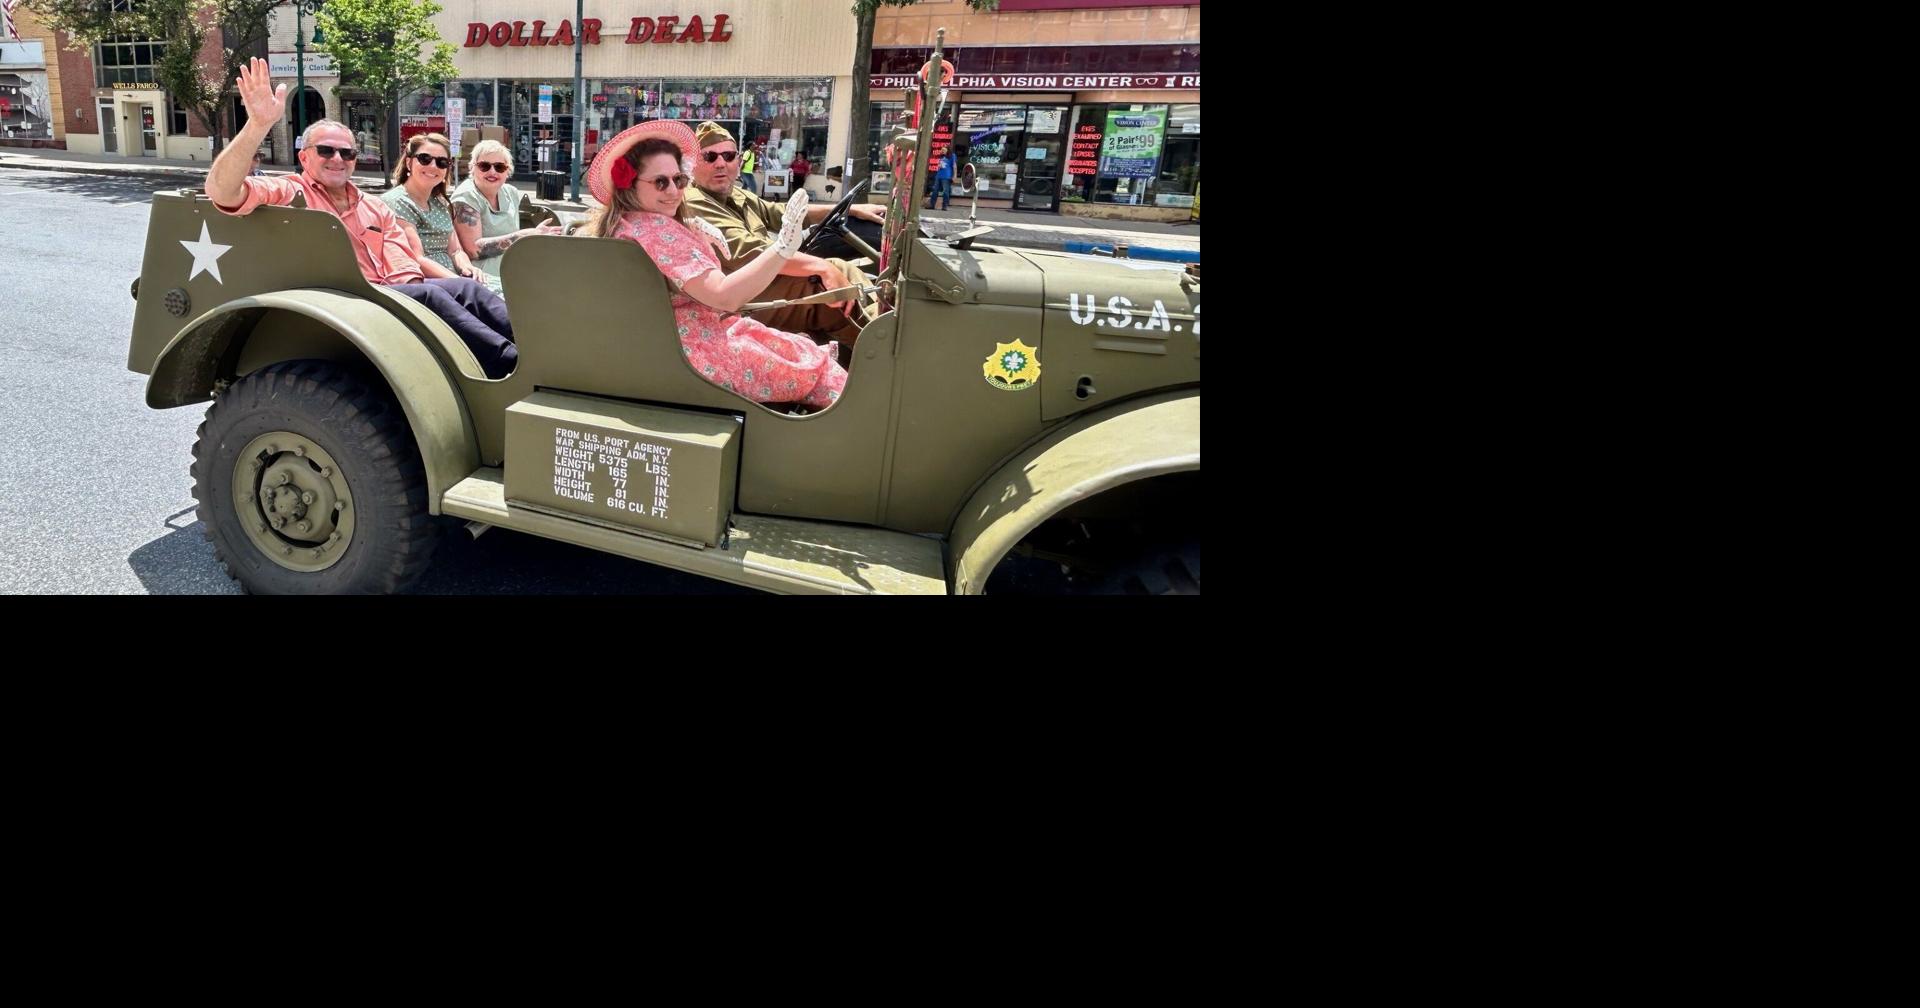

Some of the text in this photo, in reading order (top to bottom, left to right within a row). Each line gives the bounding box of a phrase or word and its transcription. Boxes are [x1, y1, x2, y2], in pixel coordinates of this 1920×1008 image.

[464, 14, 733, 48] DOLLAR DEAL
[885, 77, 1132, 87] PHILLPHIA VISION CENTER
[1109, 137, 1115, 145] 2
[1118, 136, 1135, 145] Pair
[1070, 293, 1182, 332] U.S.A.
[555, 427, 672, 457] FROM U.S. PORT AGENCY
[555, 436, 669, 465] WAR SHIPPING ADM. N.Y.
[555, 446, 671, 477] WEIGHT 5375 LBS.
[555, 456, 670, 487] LENGTH 165 IN.
[554, 475, 668, 509] HEIGHT 81 IN.
[555, 466, 669, 498] WIDTH 77 IN.
[554, 485, 668, 519] VOLUME 616 CU. FT.
